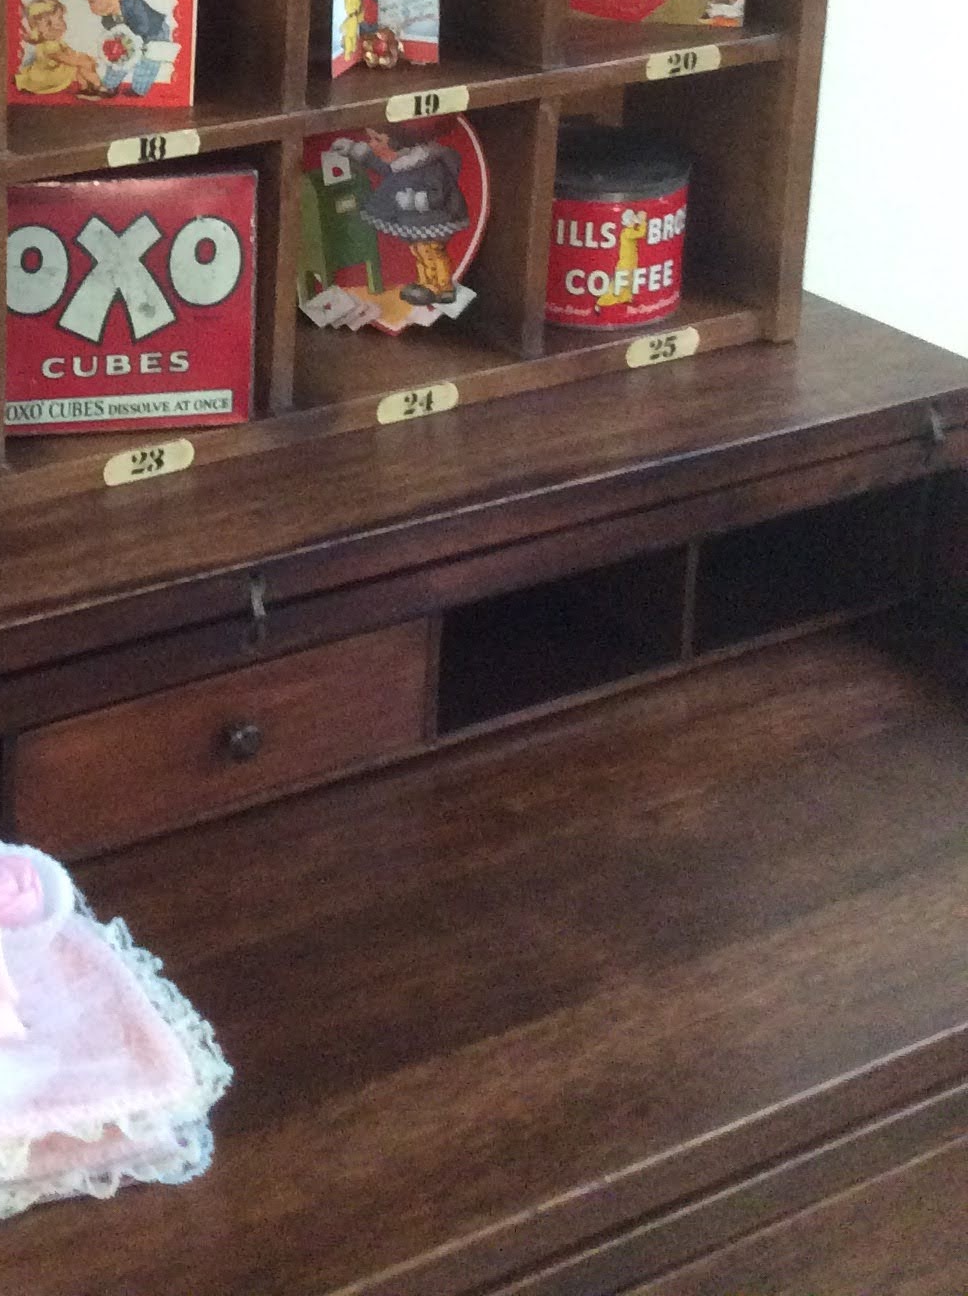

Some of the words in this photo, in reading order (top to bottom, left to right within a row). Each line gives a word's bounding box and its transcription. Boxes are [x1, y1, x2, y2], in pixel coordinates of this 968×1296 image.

[667, 51, 697, 75] 20
[413, 94, 440, 116] 19
[138, 136, 167, 162] 18
[556, 218, 617, 249] ILLS
[647, 206, 687, 245] BRO
[6, 211, 243, 346] OXO
[565, 260, 674, 296] COFFEE
[649, 335, 677, 360] 25
[42, 350, 190, 379] CUBES
[48, 400, 105, 419] CUBES
[108, 401, 171, 416] DISSOLVE
[173, 399, 190, 412] AT
[193, 397, 229, 411] ONCE
[404, 391, 433, 415] 24
[131, 448, 165, 475] 23
